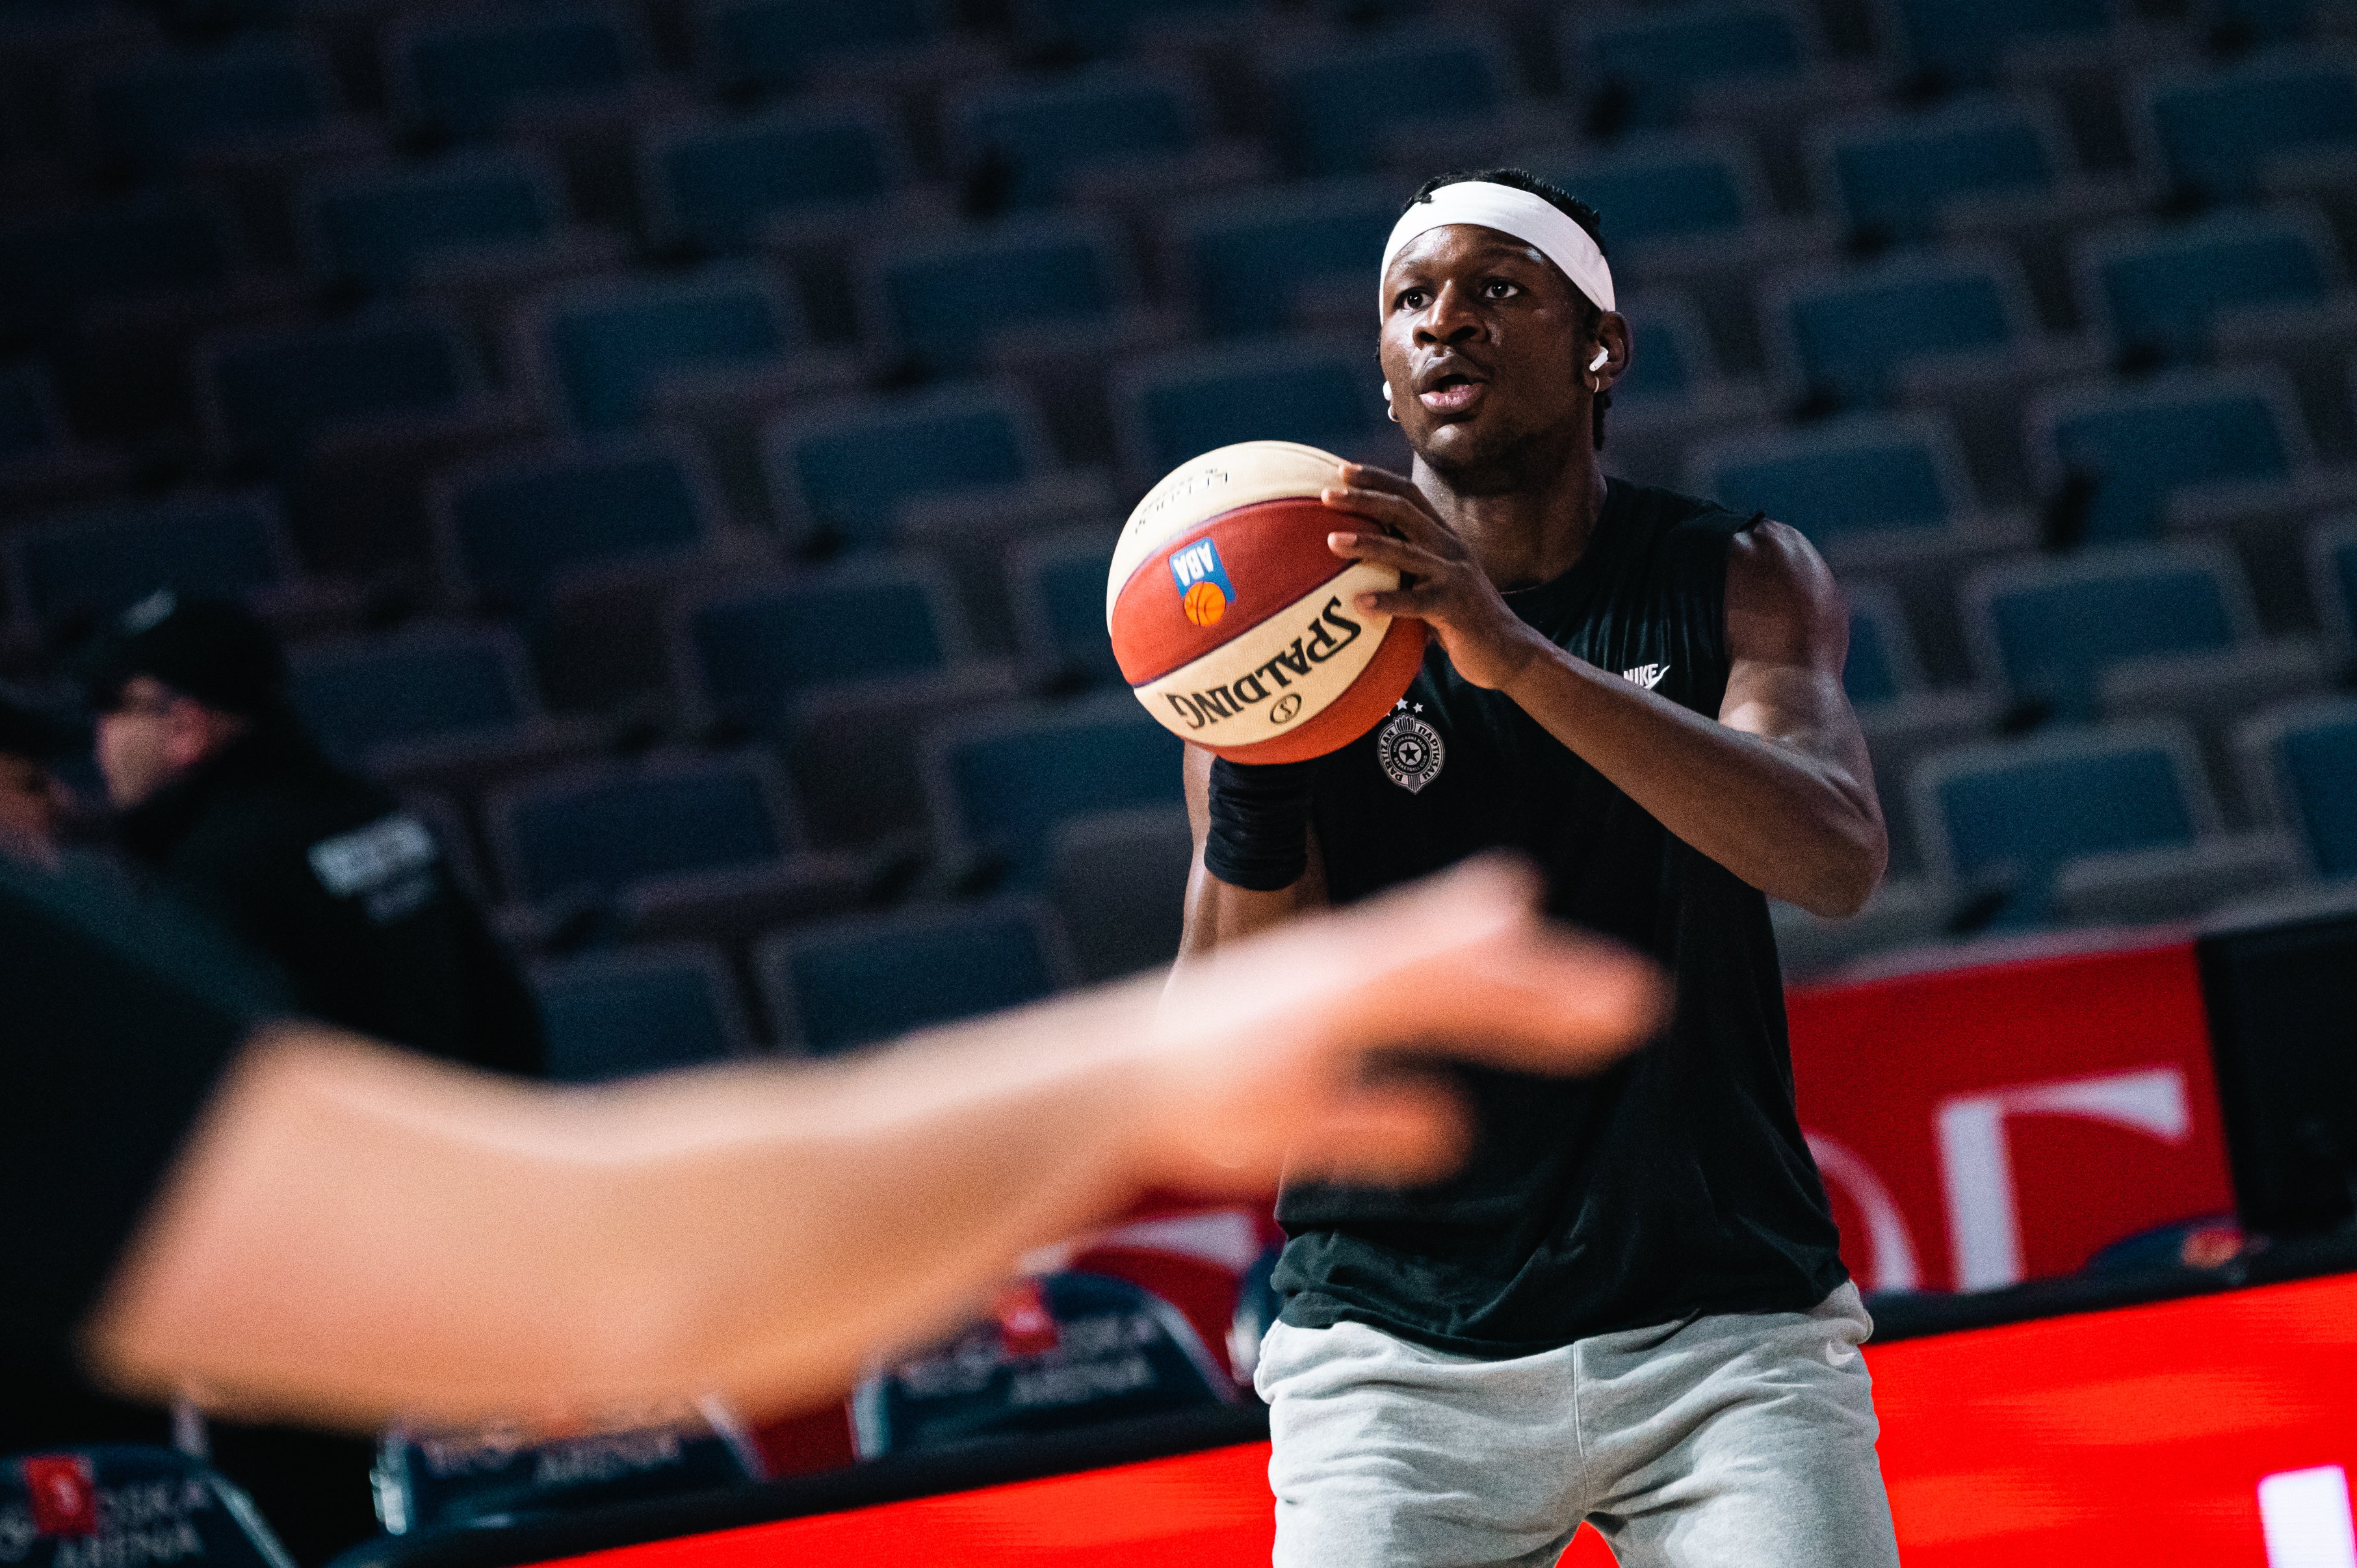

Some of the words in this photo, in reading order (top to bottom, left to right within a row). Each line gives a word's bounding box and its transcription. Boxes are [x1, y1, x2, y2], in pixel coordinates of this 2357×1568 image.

[1173, 542, 1214, 586] ABA
[1166, 596, 1362, 729] SPALDING
[1623, 663, 1658, 686] NIKE
[1381, 729, 1404, 781] PARTIZAN
[1418, 725, 1440, 780] ПАРТИЗАН
